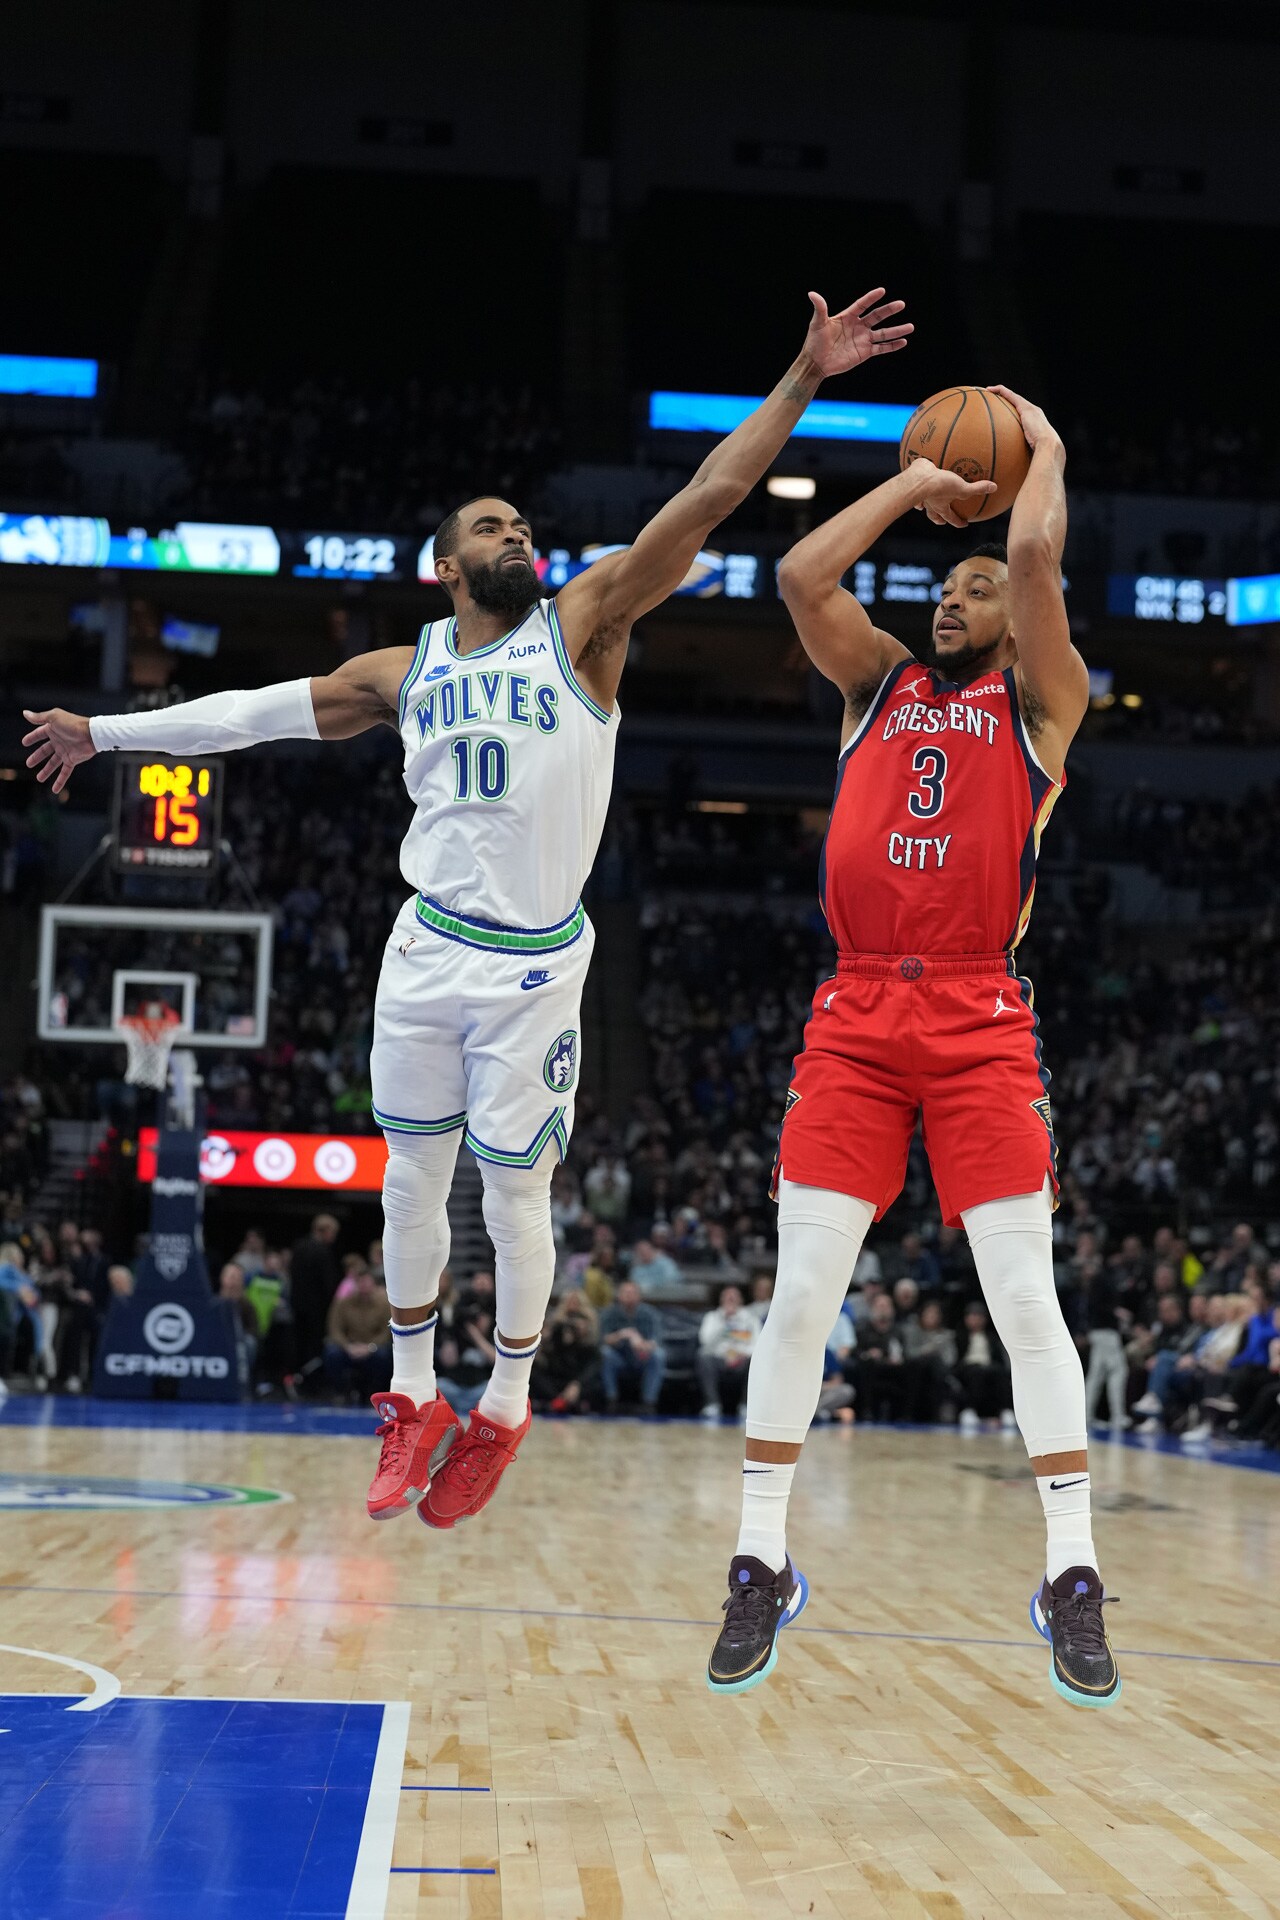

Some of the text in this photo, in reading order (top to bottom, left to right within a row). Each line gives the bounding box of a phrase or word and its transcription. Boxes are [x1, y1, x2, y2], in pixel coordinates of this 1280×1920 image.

[304, 535, 396, 573] 10:22
[430, 663, 452, 675] NIKE
[413, 670, 560, 750] WOLVES
[960, 683, 1006, 700] ibotta
[882, 701, 999, 745] CRESCENT
[450, 735, 509, 802] 10
[907, 745, 948, 819] 3
[154, 794, 199, 846] 15
[887, 831, 952, 870] CITY
[526, 970, 549, 982] NIKE
[104, 1353, 229, 1378] CFMOTO
